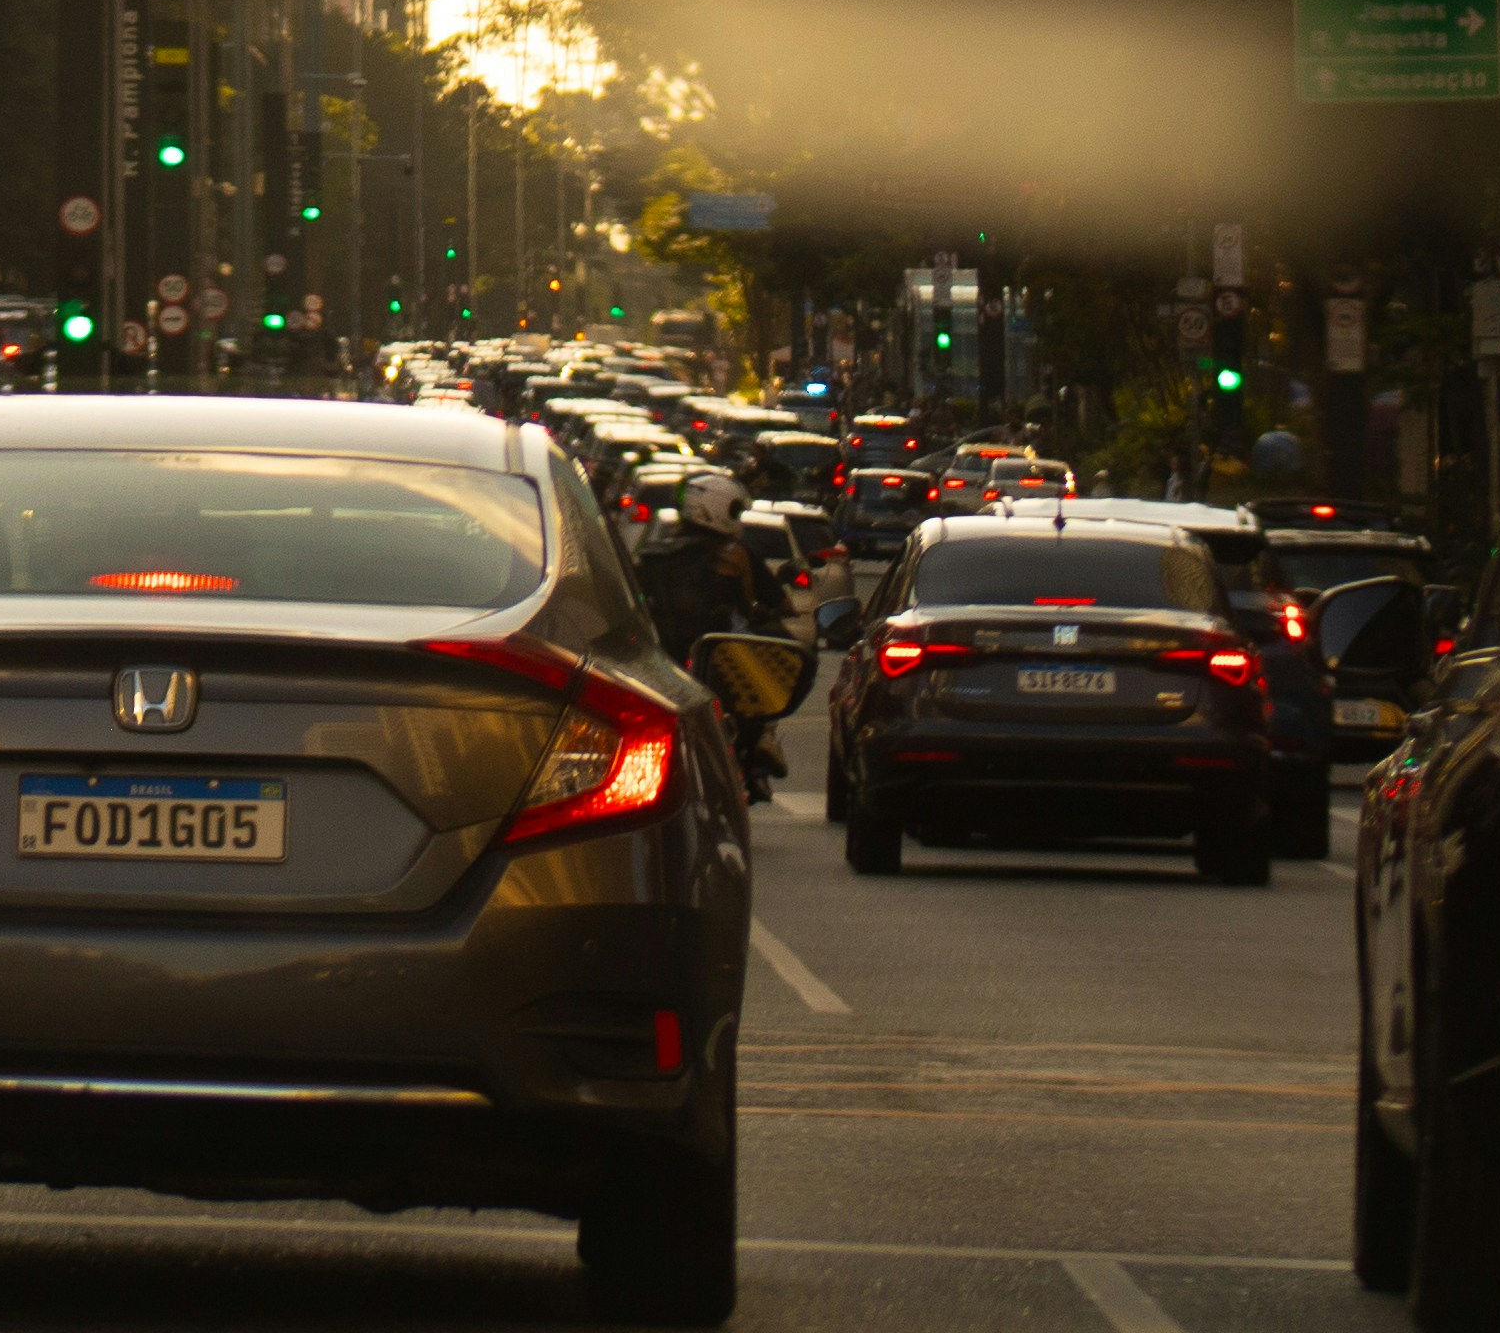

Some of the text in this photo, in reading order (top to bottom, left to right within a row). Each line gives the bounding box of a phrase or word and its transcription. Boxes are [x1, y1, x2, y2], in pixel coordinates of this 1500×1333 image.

[1346, 30, 1448, 54] Augusta
[130, 784, 174, 796] BRASIL
[43, 801, 259, 849] FOD1G05
